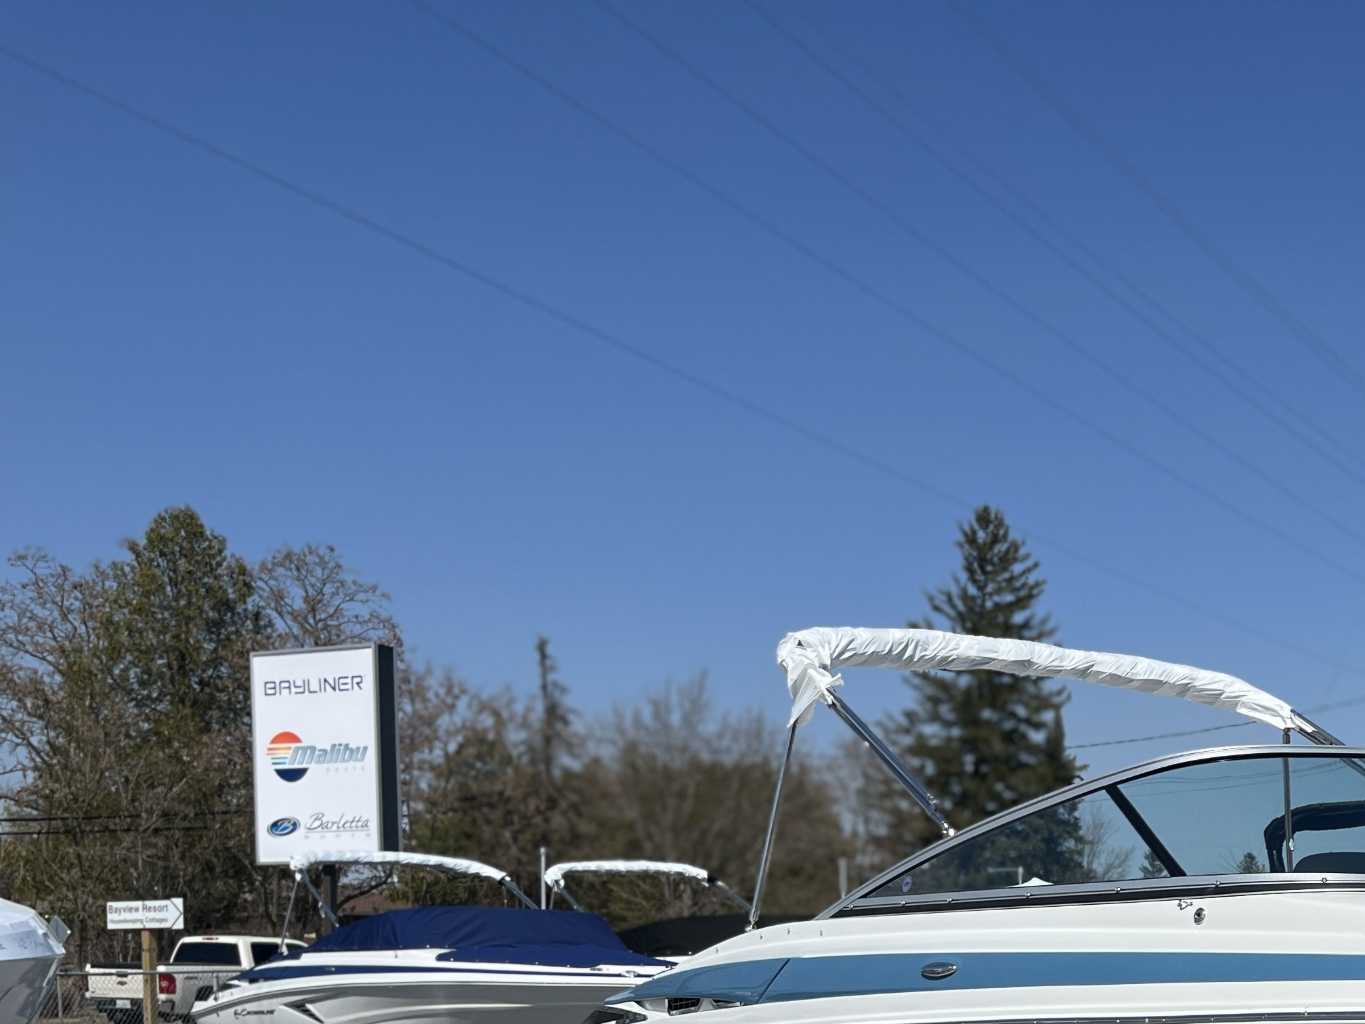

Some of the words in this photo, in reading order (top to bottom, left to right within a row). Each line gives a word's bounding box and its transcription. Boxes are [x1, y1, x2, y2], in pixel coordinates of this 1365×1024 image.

[264, 675, 363, 696] BAYLINER
[287, 743, 368, 766] Malibu
[305, 812, 370, 832] Barletta
[108, 904, 140, 916] Bayview
[142, 903, 169, 913] Resort
